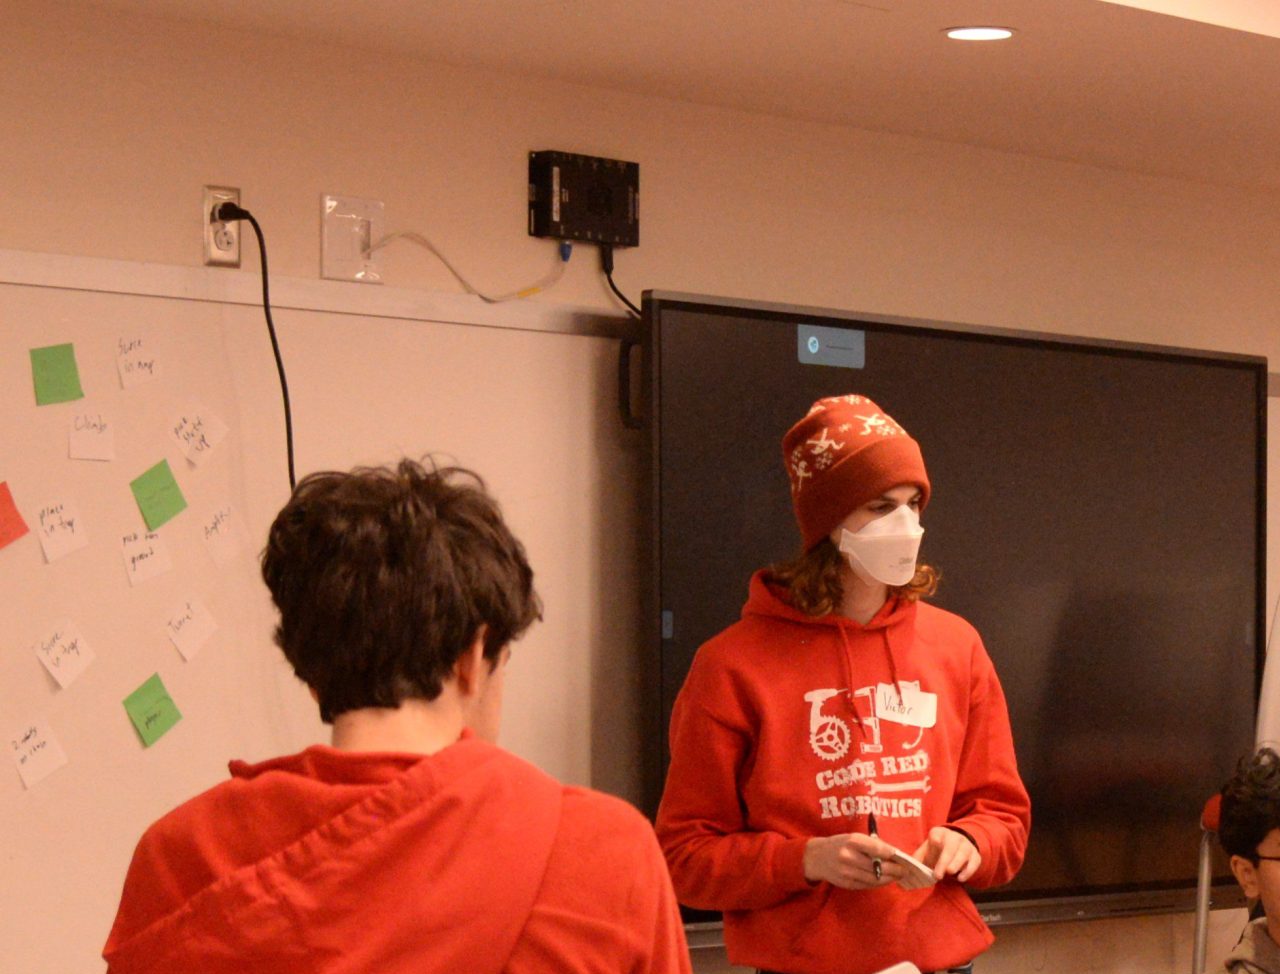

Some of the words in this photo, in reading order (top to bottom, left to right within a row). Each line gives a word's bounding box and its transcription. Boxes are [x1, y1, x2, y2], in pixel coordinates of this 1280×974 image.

[883, 691, 913, 716] Victor
[815, 760, 877, 791] CODE
[880, 749, 931, 776] RED
[819, 795, 922, 819] ROBOTICS
